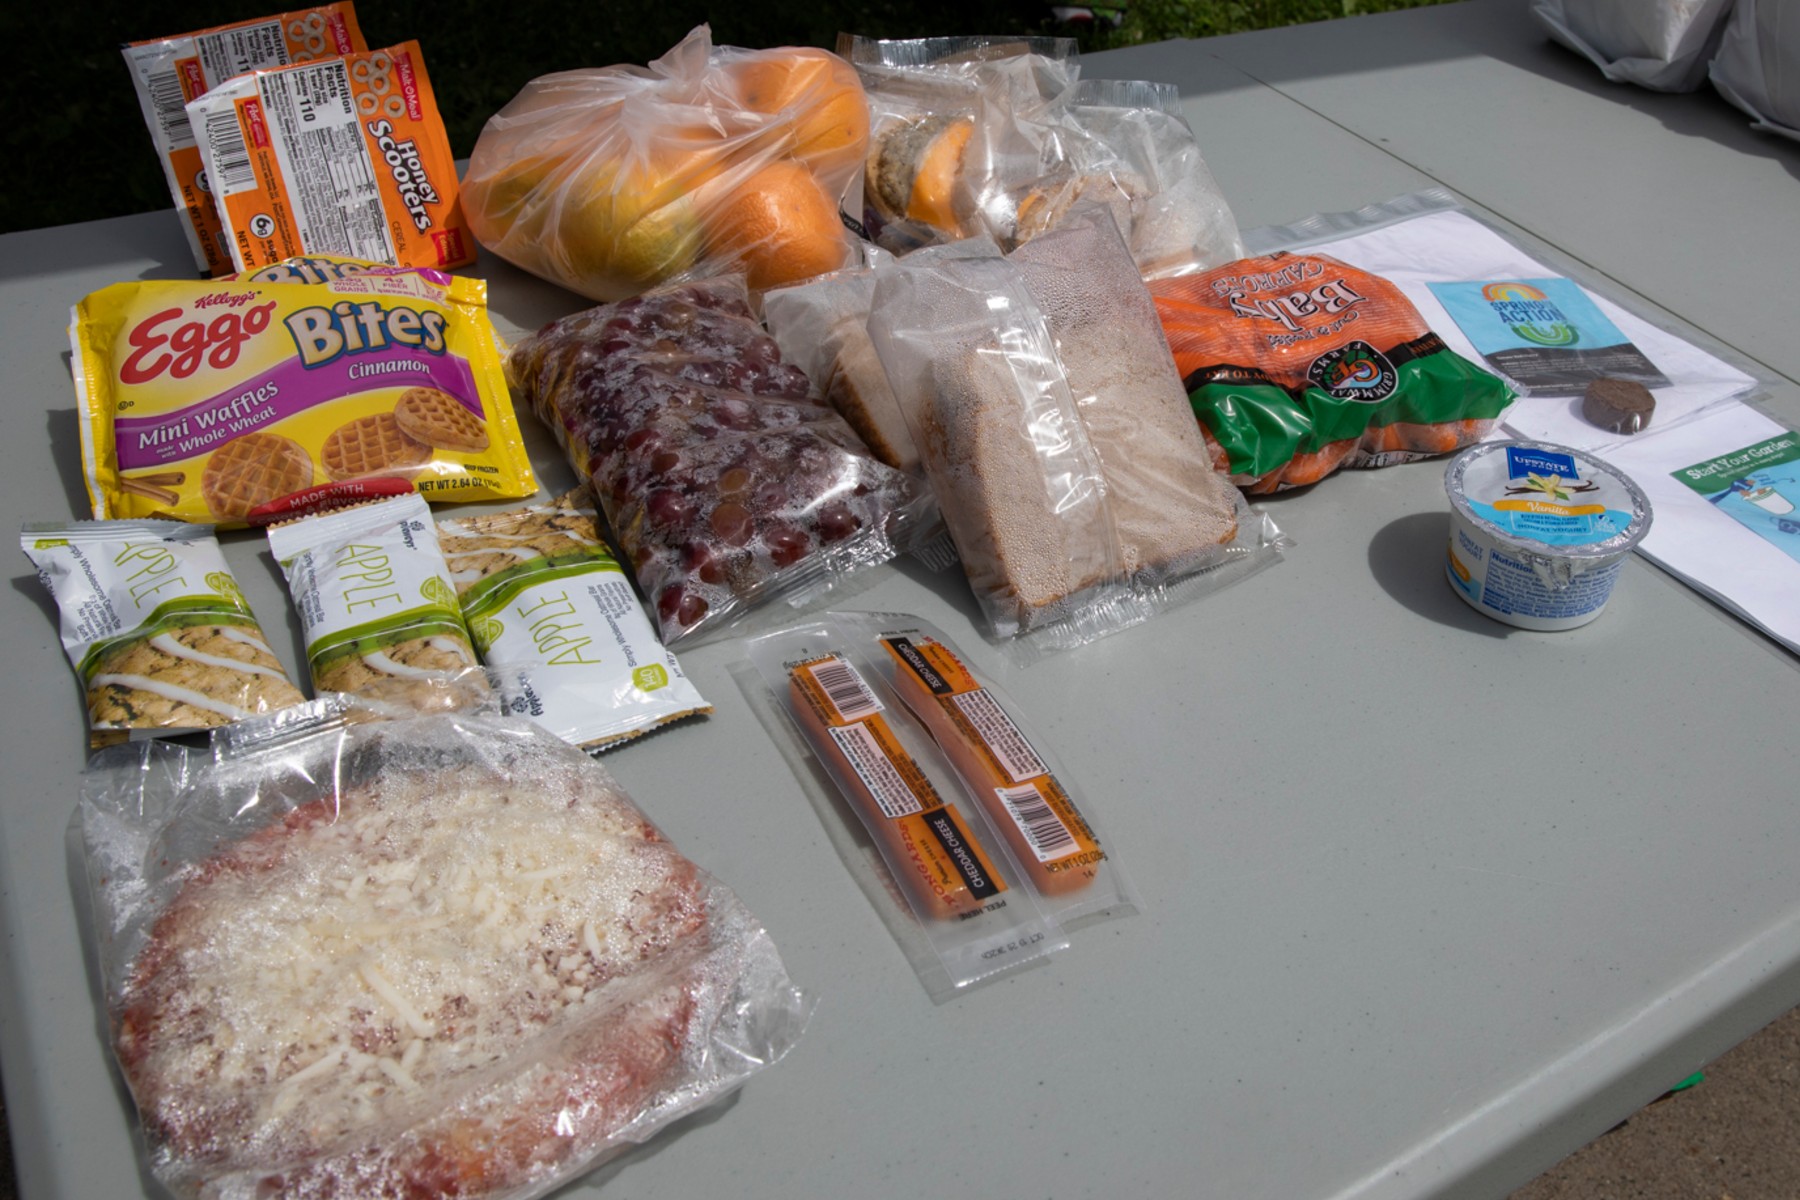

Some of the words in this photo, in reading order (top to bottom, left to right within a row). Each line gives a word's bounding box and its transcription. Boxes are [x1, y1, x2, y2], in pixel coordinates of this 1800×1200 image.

[260, 27, 274, 57] Facts
[270, 25, 287, 66] Nutritio
[236, 58, 251, 72] 11
[316, 68, 325, 90] Serving
[298, 71, 309, 96] Calories
[324, 66, 338, 98] Facts
[334, 64, 352, 114] Nutrition
[400, 64, 411, 85] Malt
[406, 96, 420, 119] Meal
[246, 103, 261, 122] Post
[299, 98, 316, 122] 110
[368, 120, 430, 232] Scooters
[398, 140, 438, 204] Honey
[184, 184, 193, 202] NET
[190, 204, 201, 218] WT
[255, 217, 271, 236] 6g
[237, 230, 249, 250] NET
[243, 251, 256, 267] WT
[266, 239, 280, 264] suga
[195, 291, 256, 310] Kellogg's
[1229, 278, 1367, 333] Baby
[1490, 300, 1545, 312] SPRING
[1500, 307, 1567, 324] ACTION
[285, 302, 446, 369] Bites
[1329, 310, 1359, 333] Cut
[119, 300, 277, 385] Eggo
[348, 358, 430, 380] Cinnamon
[1311, 341, 1361, 375] FARMS
[1327, 371, 1393, 399] GRIMMWAY
[139, 418, 191, 450] Mini
[195, 381, 279, 430] Waffles
[179, 428, 227, 453] Whole
[228, 405, 277, 433] Wheat
[1514, 456, 1570, 472] UPSTATE
[1686, 460, 1720, 480] Start
[1717, 453, 1751, 468] Your
[1748, 439, 1796, 457] Garden
[289, 490, 326, 509] MADE
[330, 484, 365, 495] WITH
[418, 481, 435, 492] NET
[437, 480, 451, 491] WT
[452, 479, 470, 489] 2.64
[472, 479, 484, 488] OZ
[1527, 501, 1570, 516] Vanilla
[79, 557, 107, 602] Wholesome
[335, 544, 402, 614] APPLE
[517, 591, 601, 666] APPLE
[606, 614, 627, 646] Wholesome
[620, 644, 637, 668] Simply
[898, 643, 925, 671] CHEDDAR
[919, 663, 942, 689] CHEESE
[934, 818, 959, 848] CHEESE
[900, 824, 957, 906] BONGARDS
[953, 846, 984, 888] CHEDDAR
[1062, 859, 1073, 870] WT
[1077, 854, 1091, 865] OZ
[959, 908, 984, 921] HERE
[987, 900, 1007, 913] PEEL
